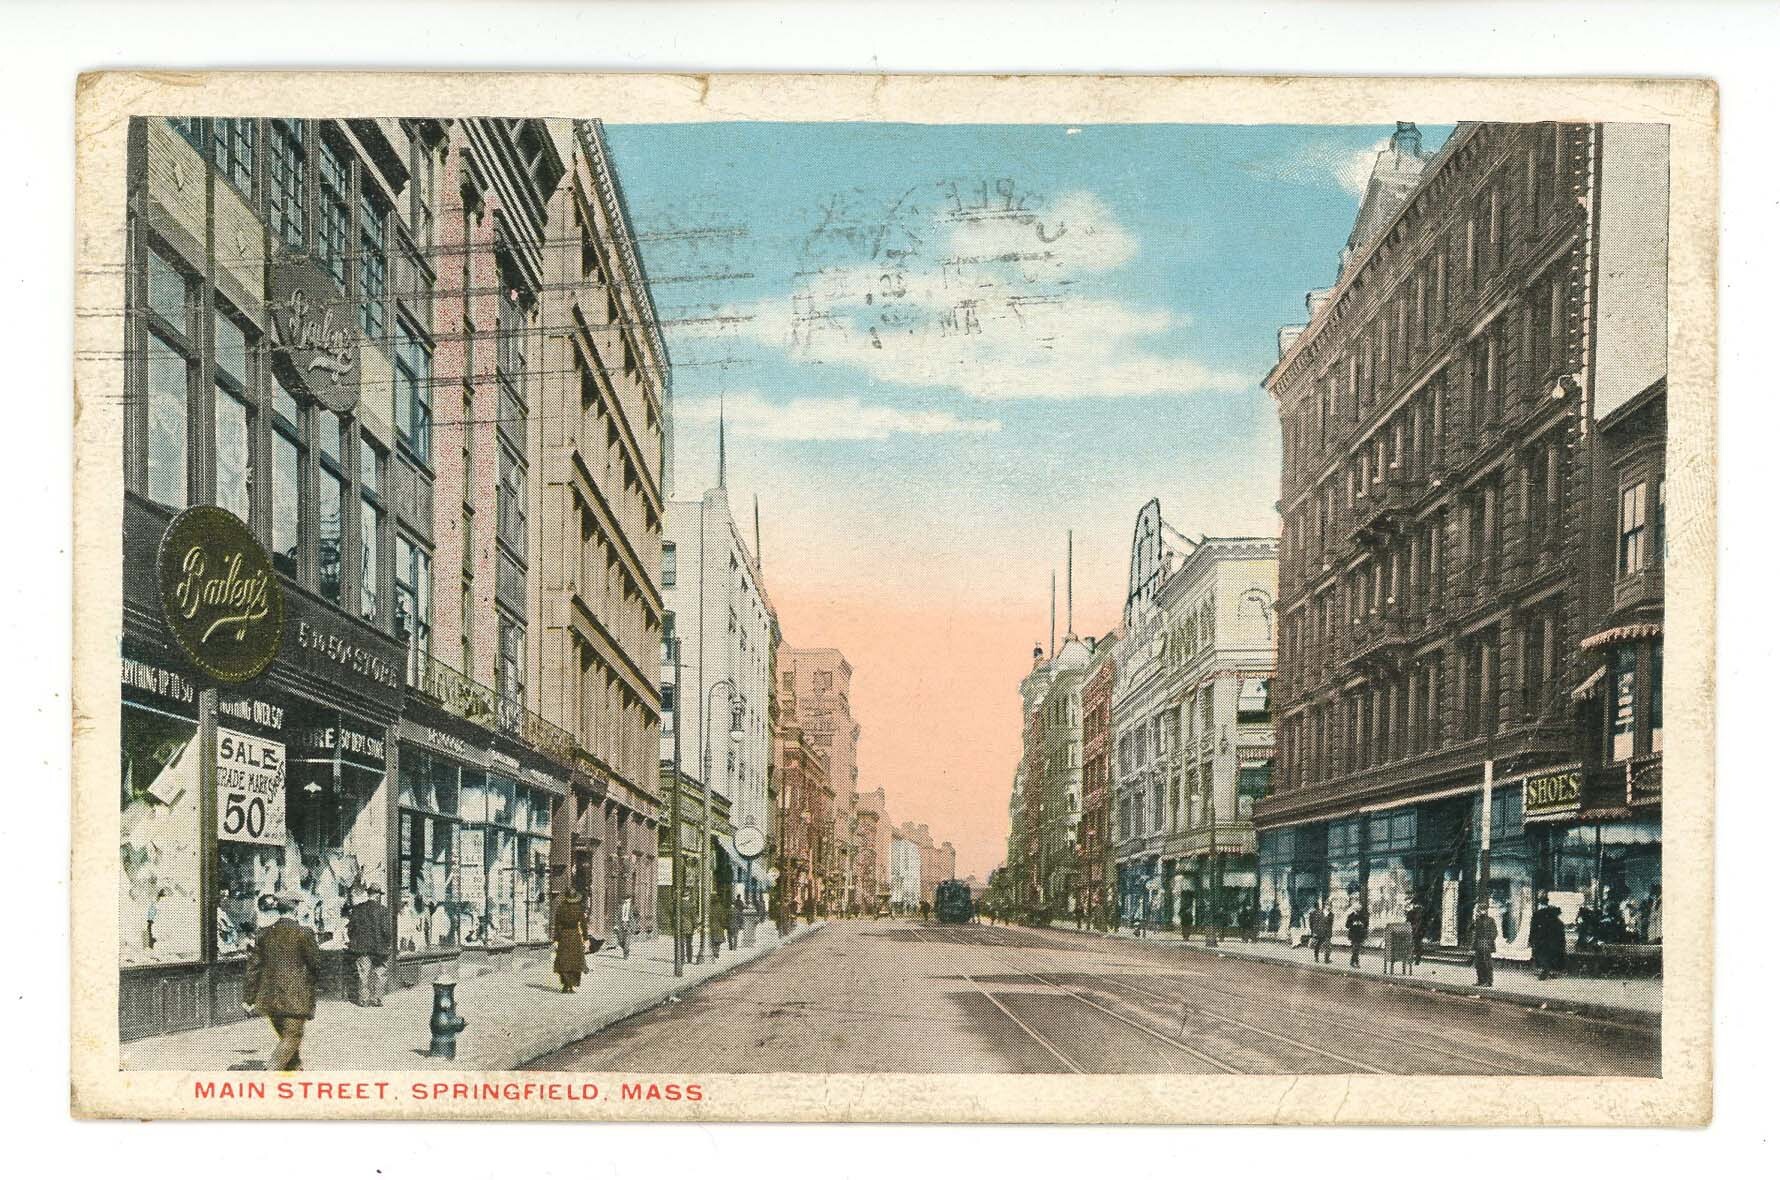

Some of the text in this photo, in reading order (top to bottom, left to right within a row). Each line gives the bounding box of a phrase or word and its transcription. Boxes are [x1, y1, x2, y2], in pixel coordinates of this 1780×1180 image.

[176, 546, 270, 643] Bailey's
[1528, 774, 1580, 804] SHOES
[223, 793, 266, 839] 50
